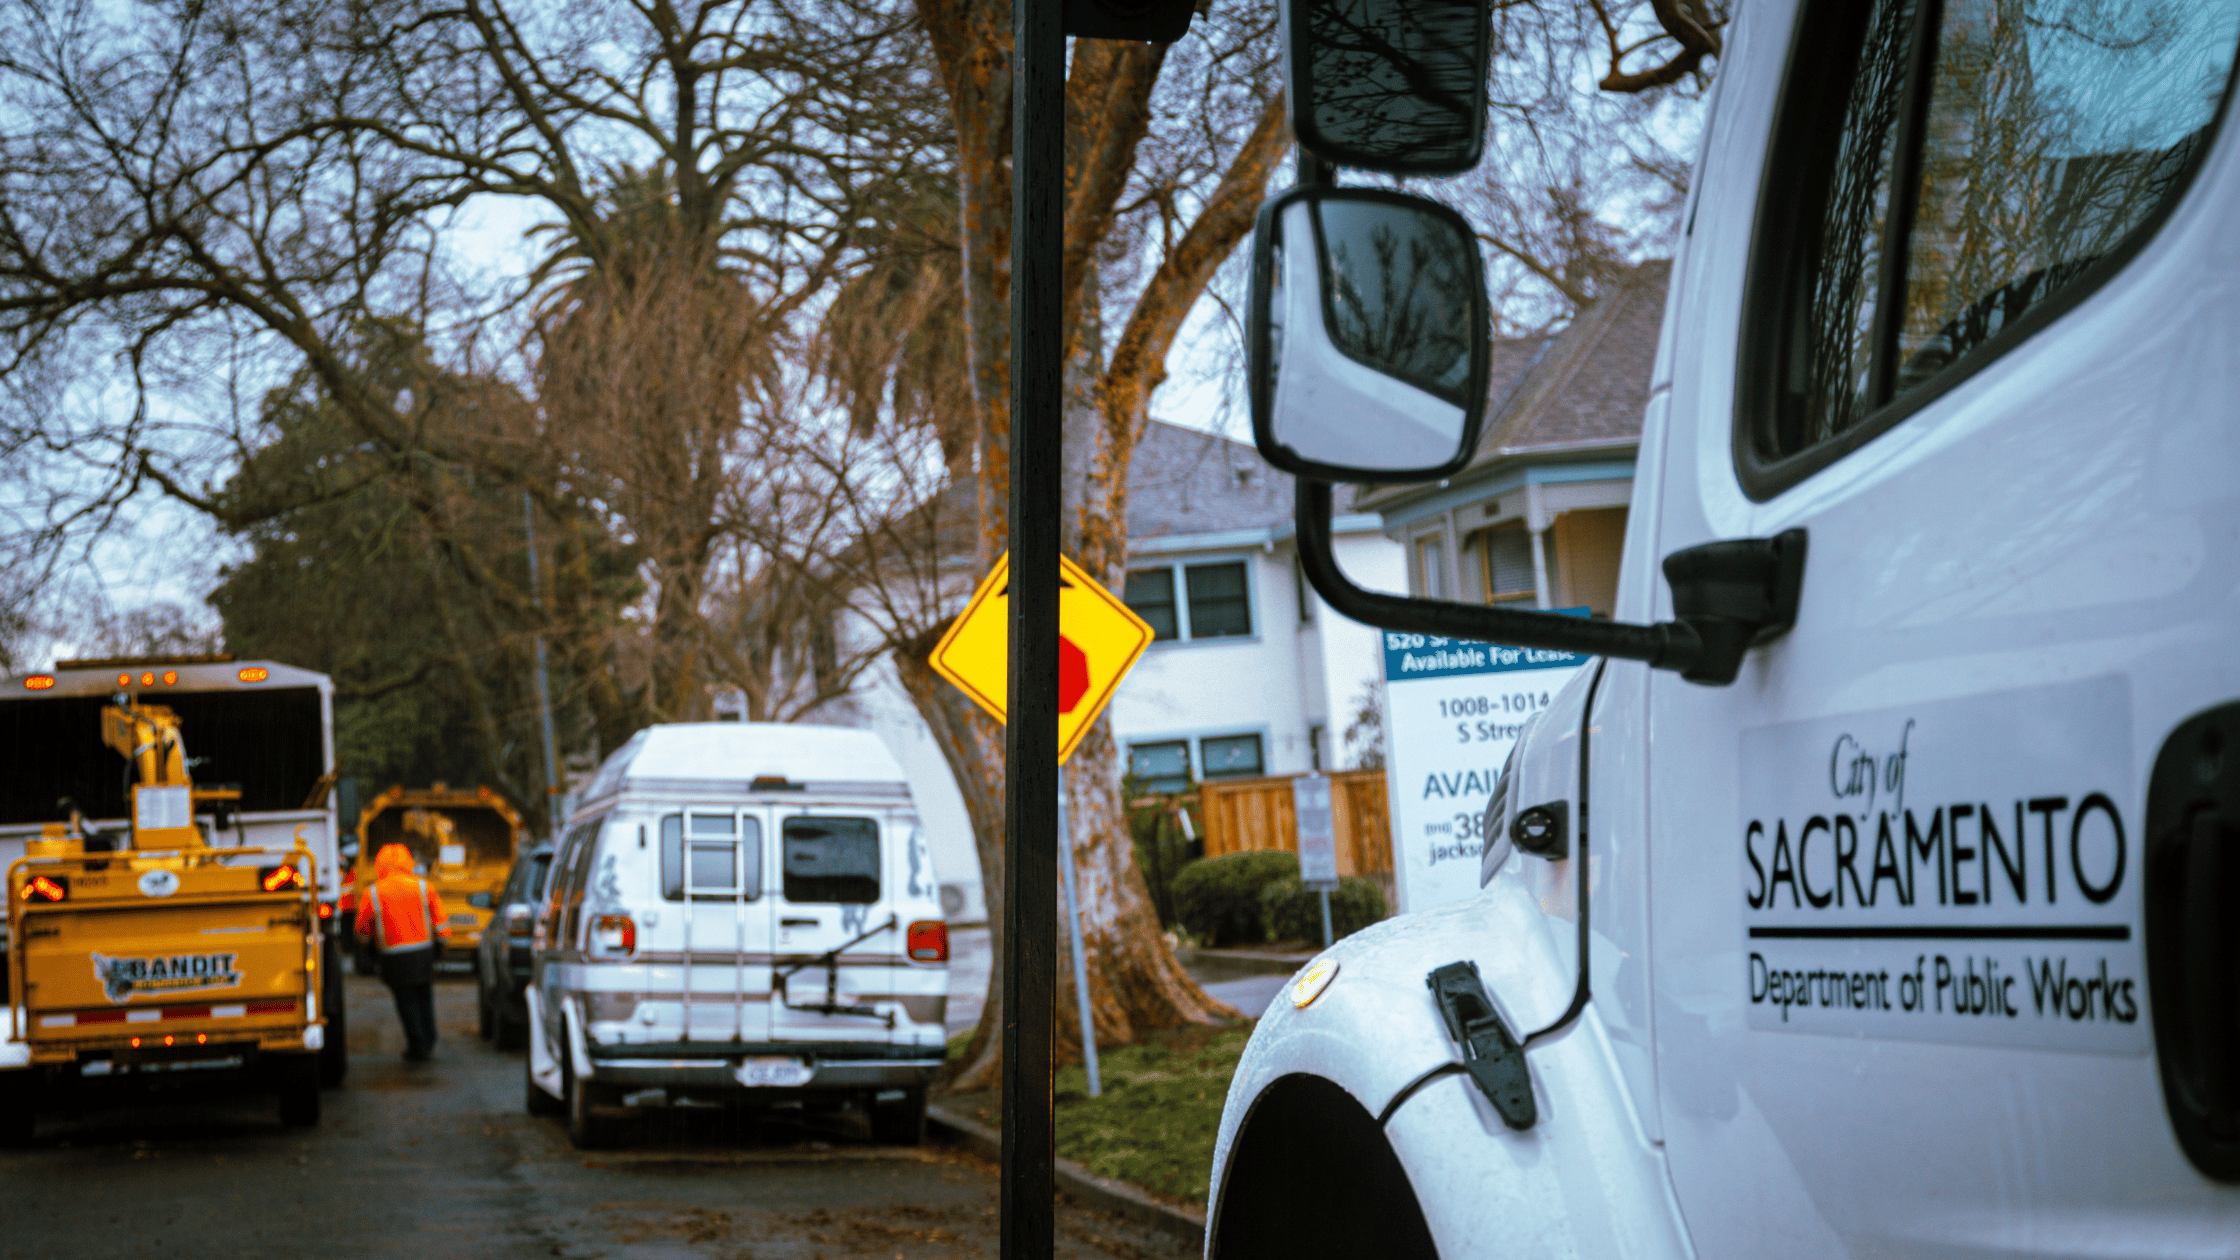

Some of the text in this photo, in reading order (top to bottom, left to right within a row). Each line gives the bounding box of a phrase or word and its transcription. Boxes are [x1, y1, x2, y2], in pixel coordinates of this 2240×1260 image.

[1386, 633, 1425, 650] 520
[1401, 648, 1486, 672] Available
[1489, 646, 1521, 666] For
[1439, 691, 1549, 718] 1008-1014
[1457, 721, 1471, 743] S
[1830, 719, 1915, 822] City of
[1746, 791, 2127, 909] SACRAMENTO
[131, 953, 235, 978] BANDIT
[1750, 952, 2138, 1024] Department of Public Works
